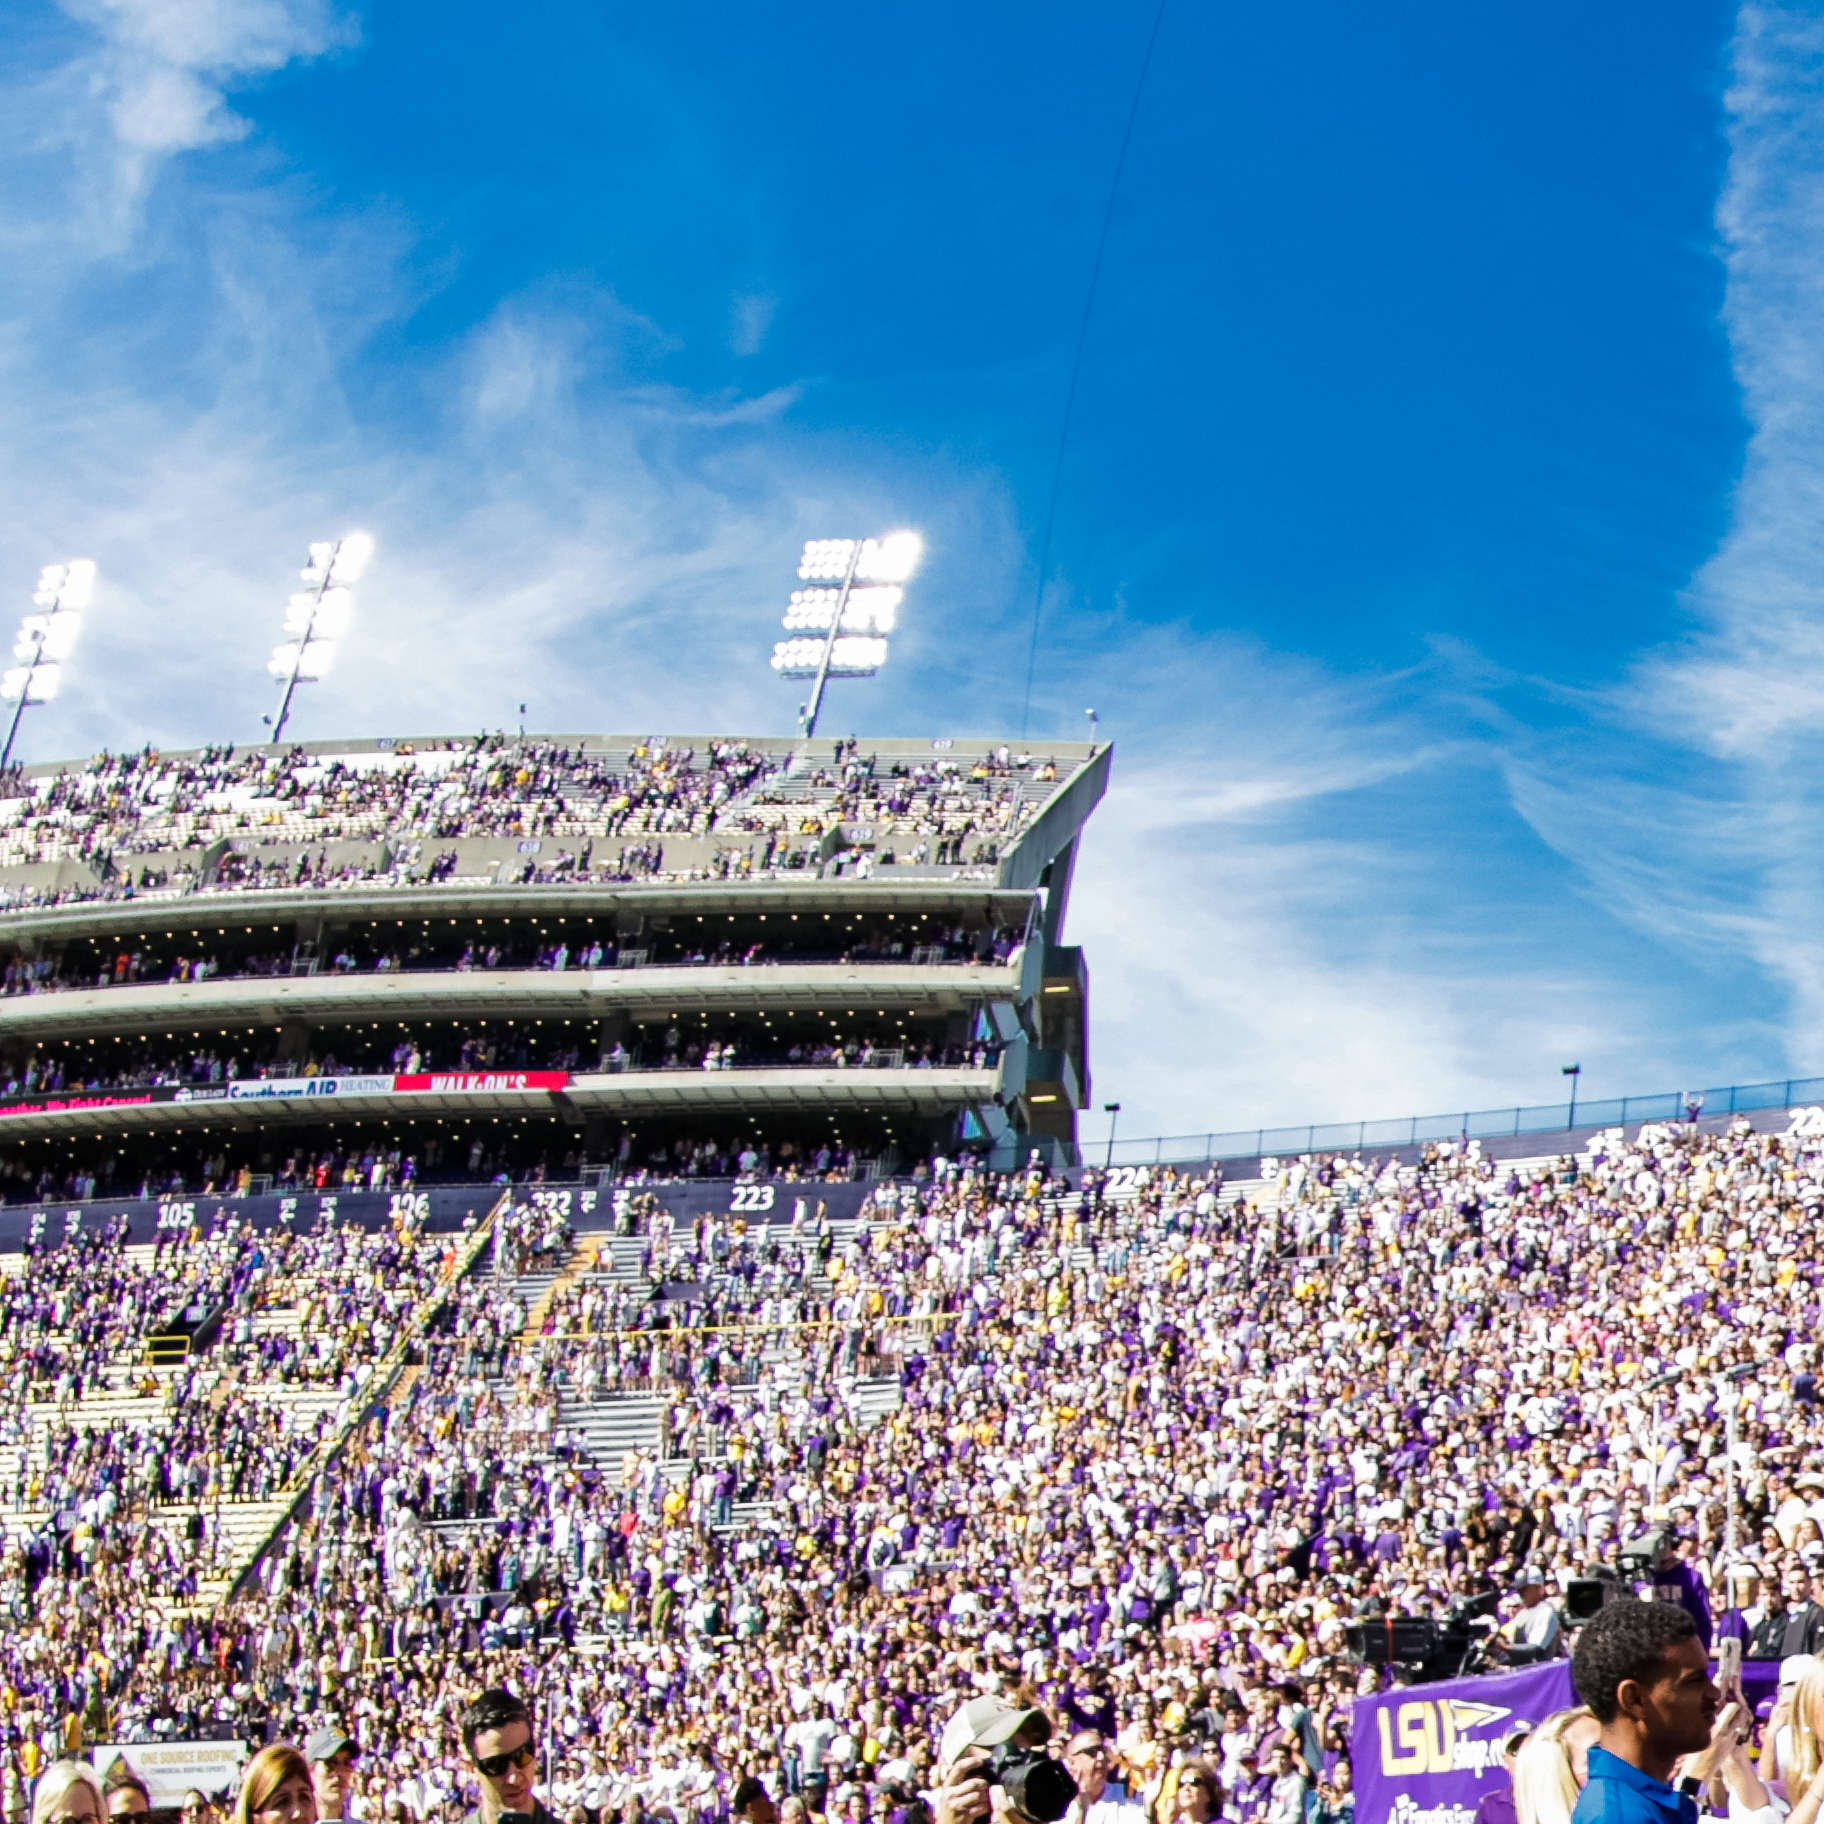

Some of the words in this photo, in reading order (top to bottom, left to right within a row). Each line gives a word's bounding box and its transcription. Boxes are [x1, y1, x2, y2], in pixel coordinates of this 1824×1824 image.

[730, 1186, 774, 1210] 223
[157, 1203, 195, 1228] 105
[1377, 1699, 1456, 1777] LSU
